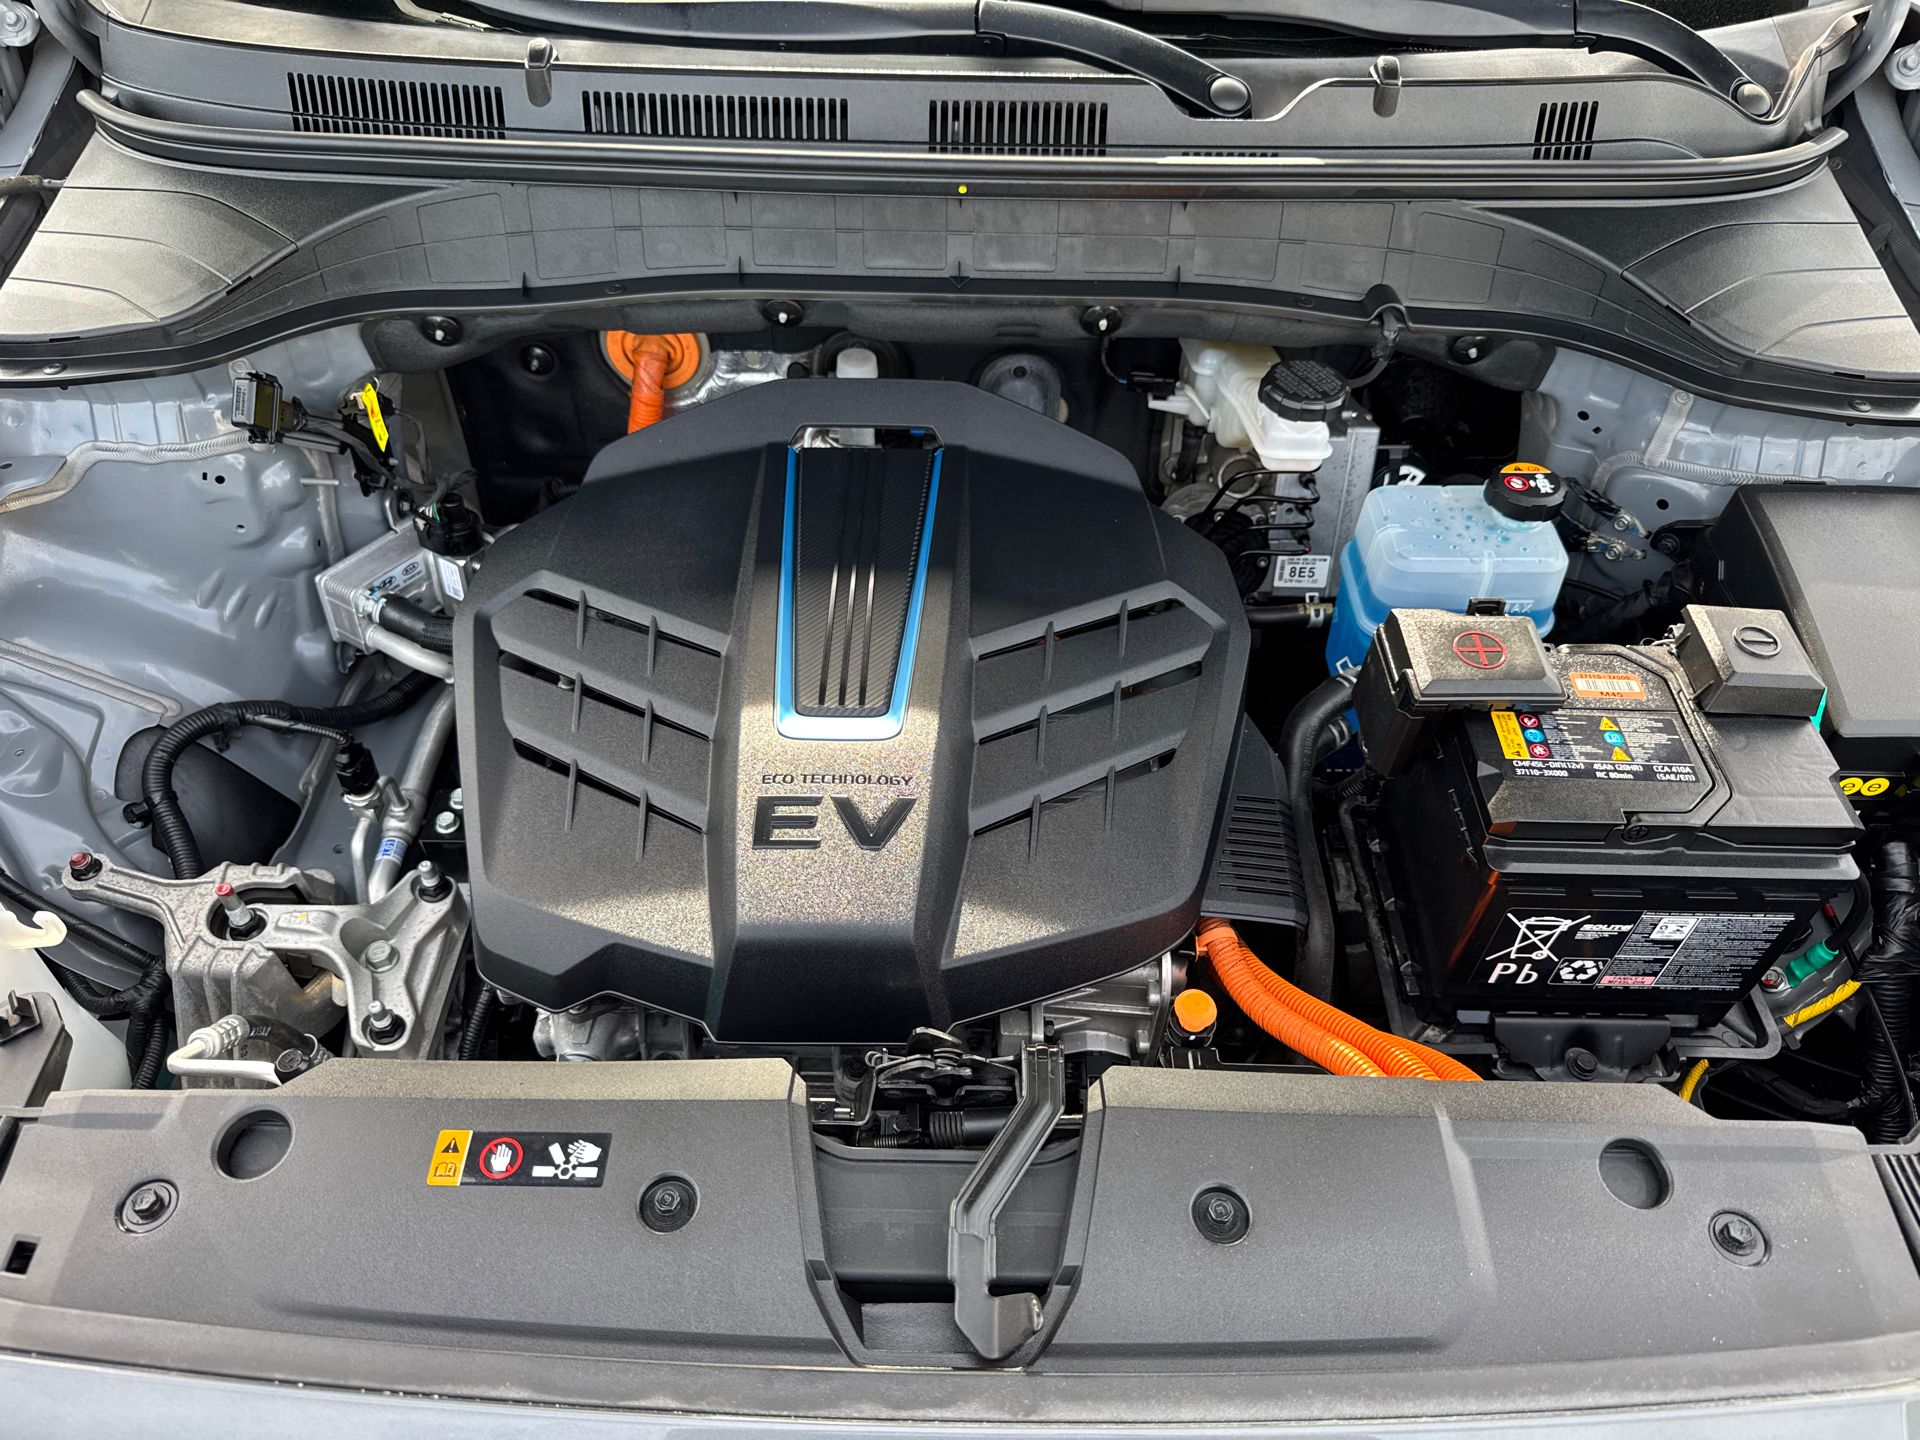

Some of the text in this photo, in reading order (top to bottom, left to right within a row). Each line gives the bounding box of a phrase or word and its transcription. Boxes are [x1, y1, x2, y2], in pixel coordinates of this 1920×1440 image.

[1289, 566, 1316, 578] 8E5
[1615, 764, 1644, 772] (20HR)
[1653, 765, 1671, 773] CCA
[1672, 766, 1693, 774] 410A
[762, 774, 913, 786] ECO TECHNOLOGY
[752, 795, 918, 850] EV
[1487, 962, 1539, 985] Pb
